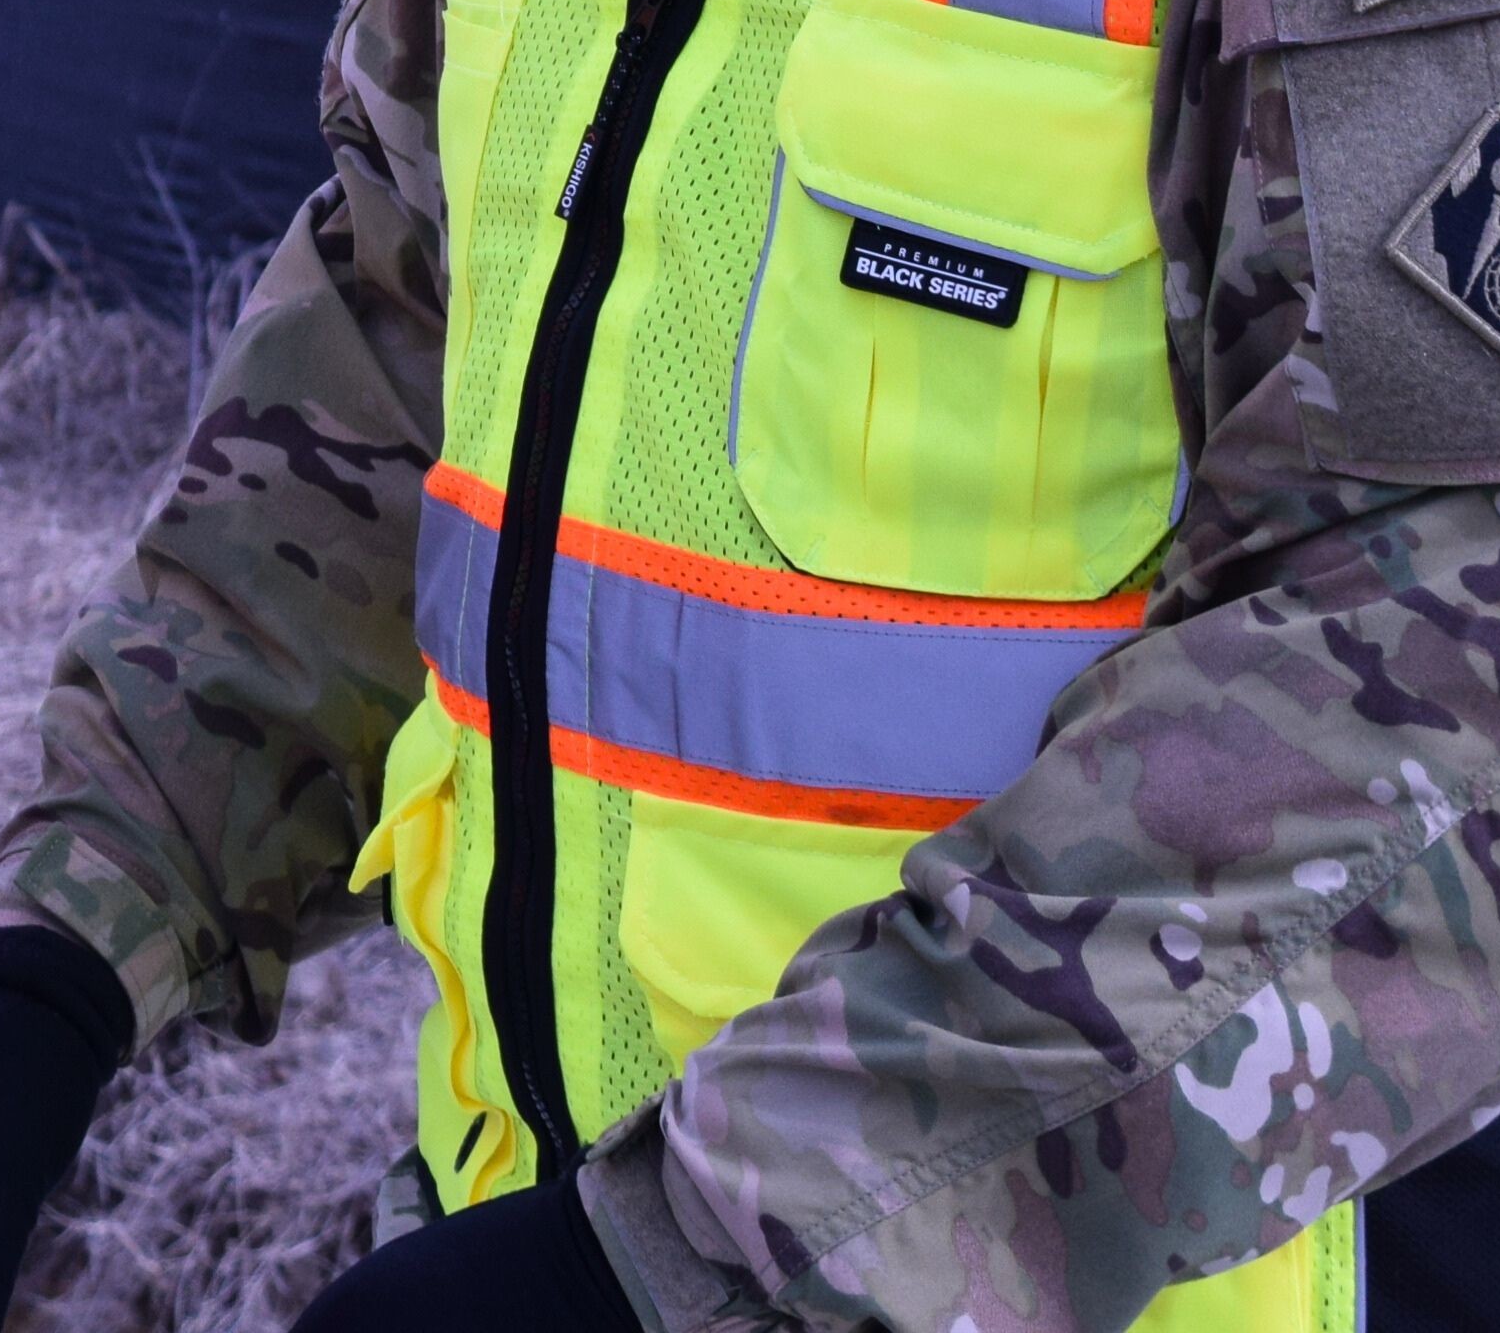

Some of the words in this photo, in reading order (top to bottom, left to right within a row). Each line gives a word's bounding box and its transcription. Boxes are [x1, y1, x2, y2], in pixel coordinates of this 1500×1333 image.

[561, 142, 593, 209] KISHIGO
[855, 256, 924, 291] BLACK
[883, 242, 986, 279] PREMIUM
